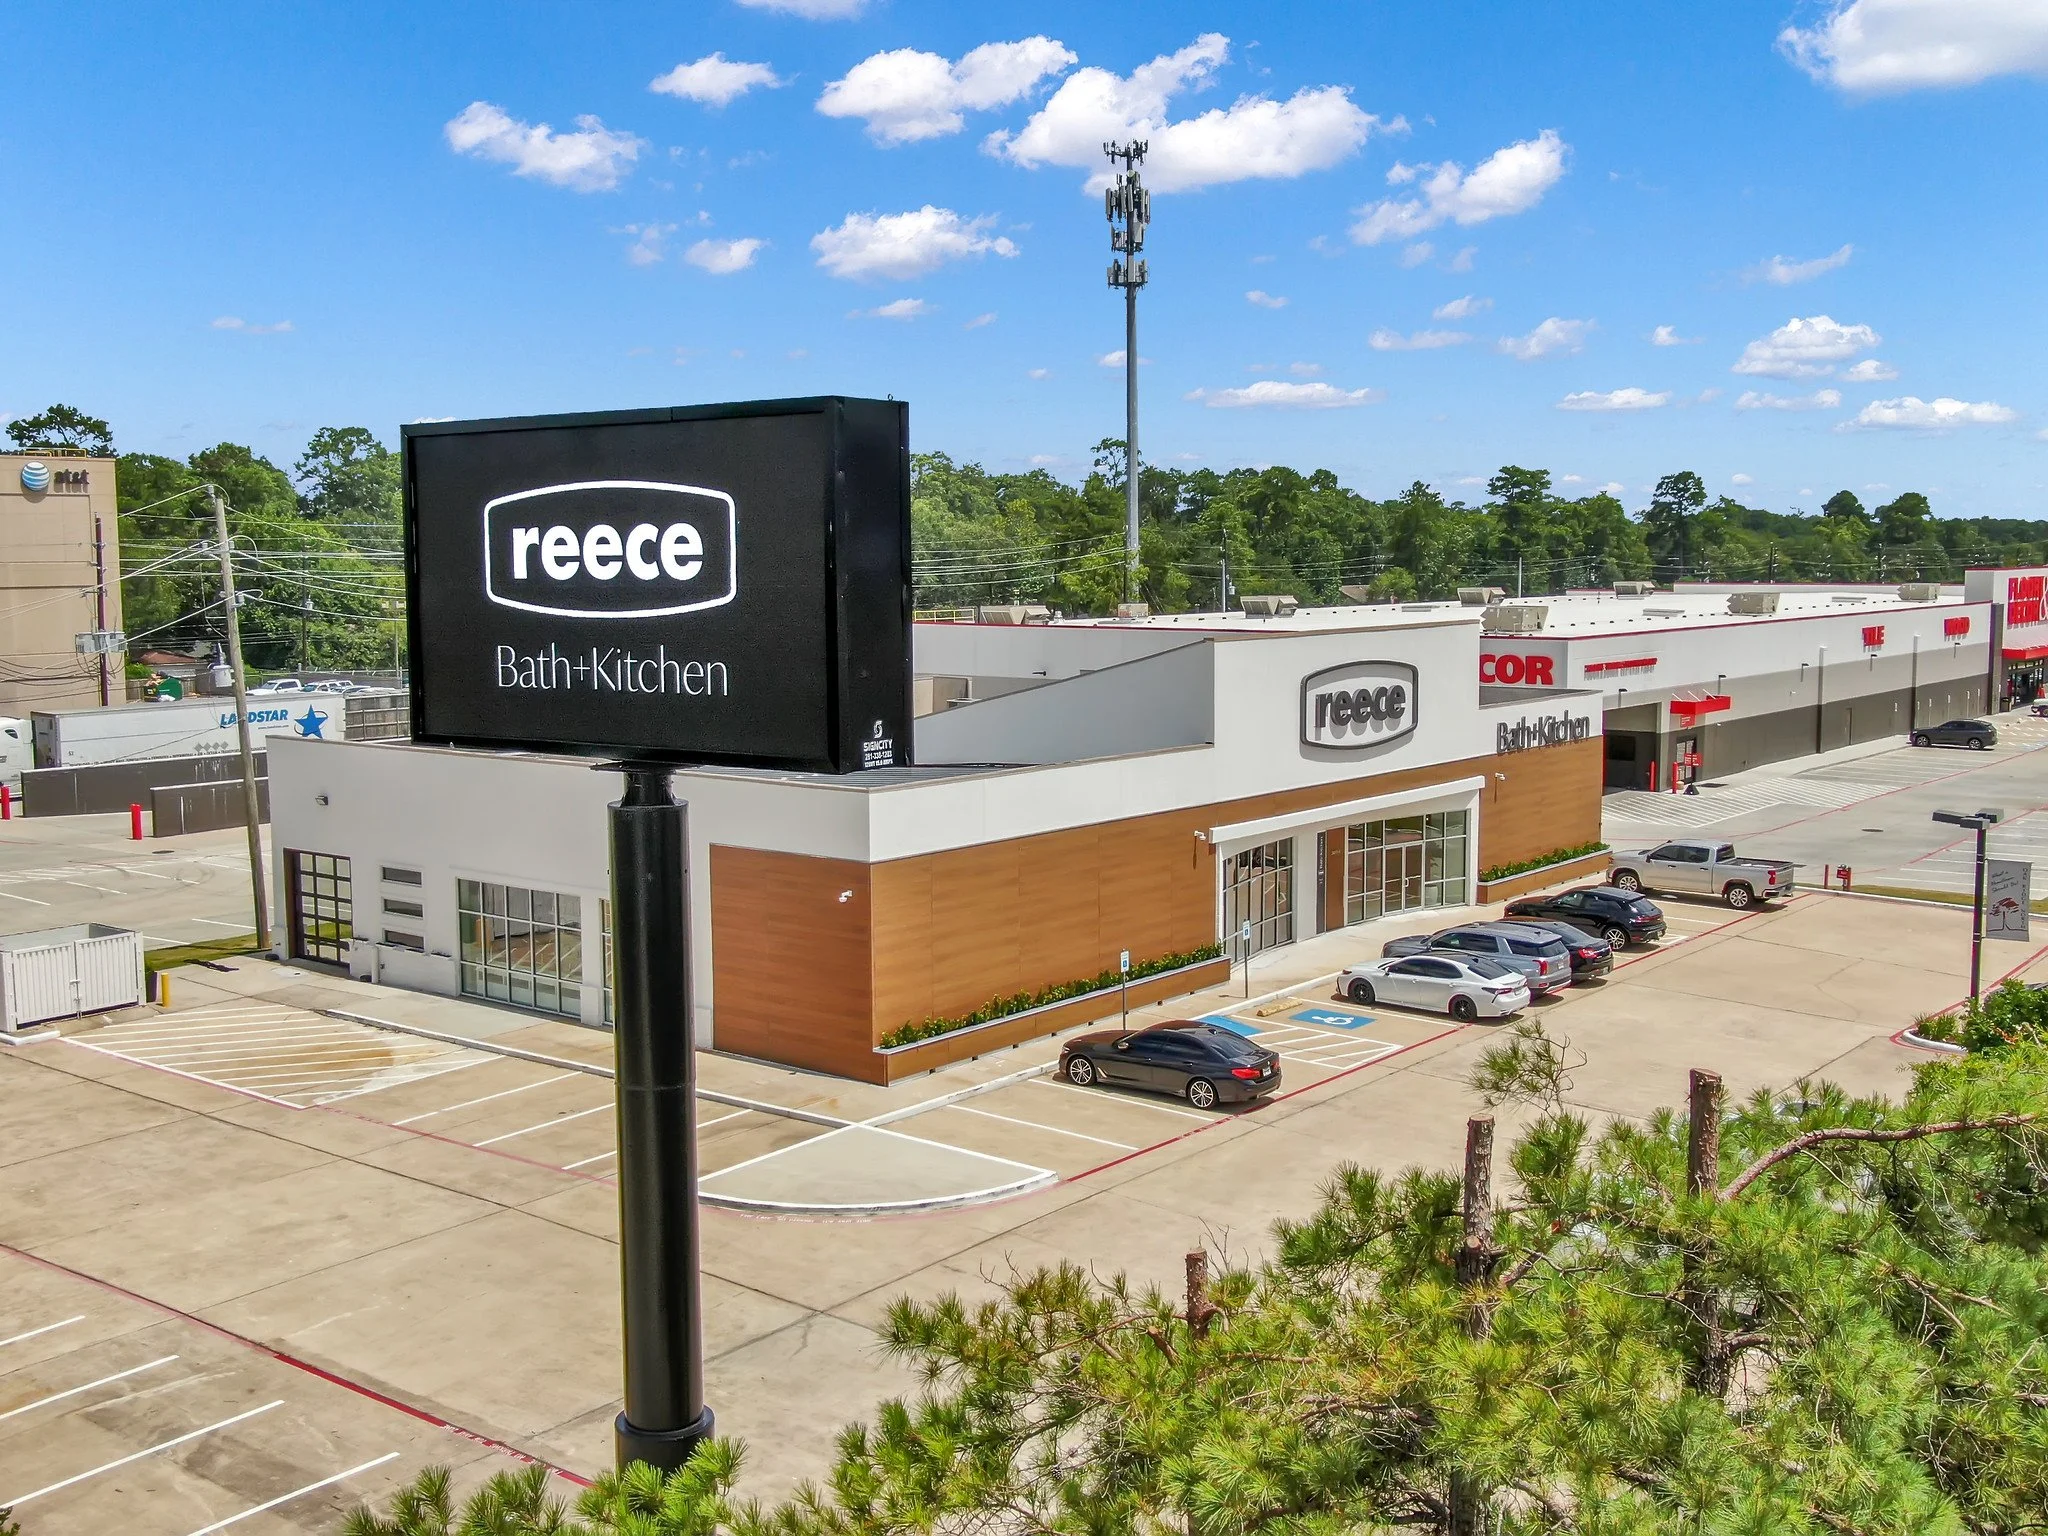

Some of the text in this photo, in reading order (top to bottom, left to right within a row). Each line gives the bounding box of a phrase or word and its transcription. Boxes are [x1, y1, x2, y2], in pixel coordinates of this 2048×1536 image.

[512, 522, 704, 581] reece
[497, 641, 728, 697] Bath+Kitchen
[220, 709, 289, 726] LADSTAR
[1315, 685, 1406, 728] reece
[1497, 710, 1590, 753] Bath+Kitchen
